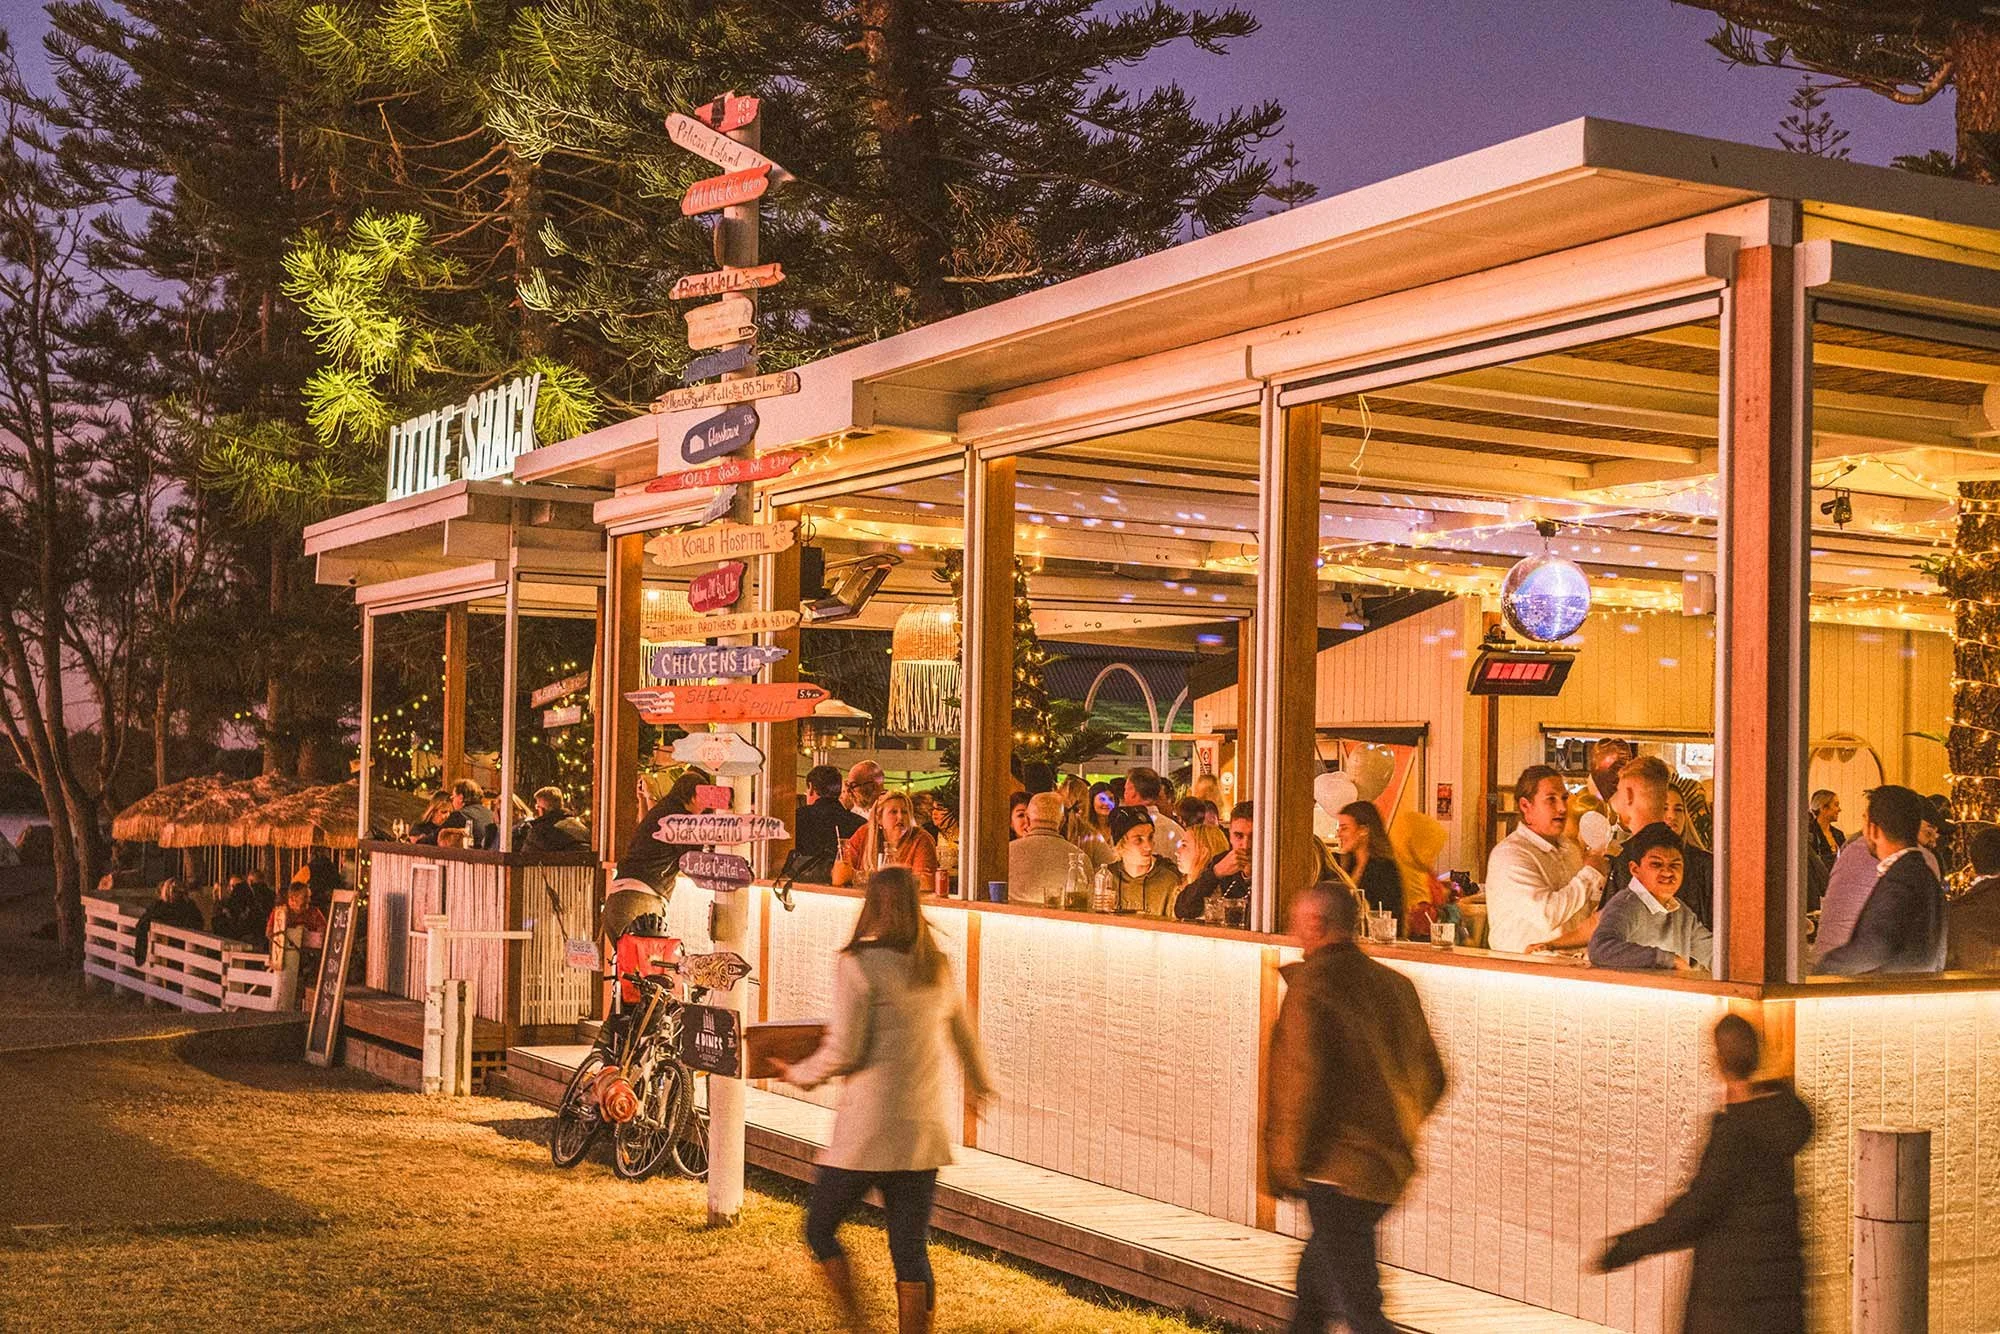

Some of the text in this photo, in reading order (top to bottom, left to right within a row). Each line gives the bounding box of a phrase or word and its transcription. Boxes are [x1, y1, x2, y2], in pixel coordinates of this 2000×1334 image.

[386, 372, 541, 502] LITTLE SHACK
[681, 535, 715, 558] KOALA
[651, 625, 667, 638] THE
[670, 623, 693, 636] THREE
[698, 618, 737, 633] BROTHERS
[661, 649, 738, 676] CHICKENS
[750, 700, 796, 715] POINT
